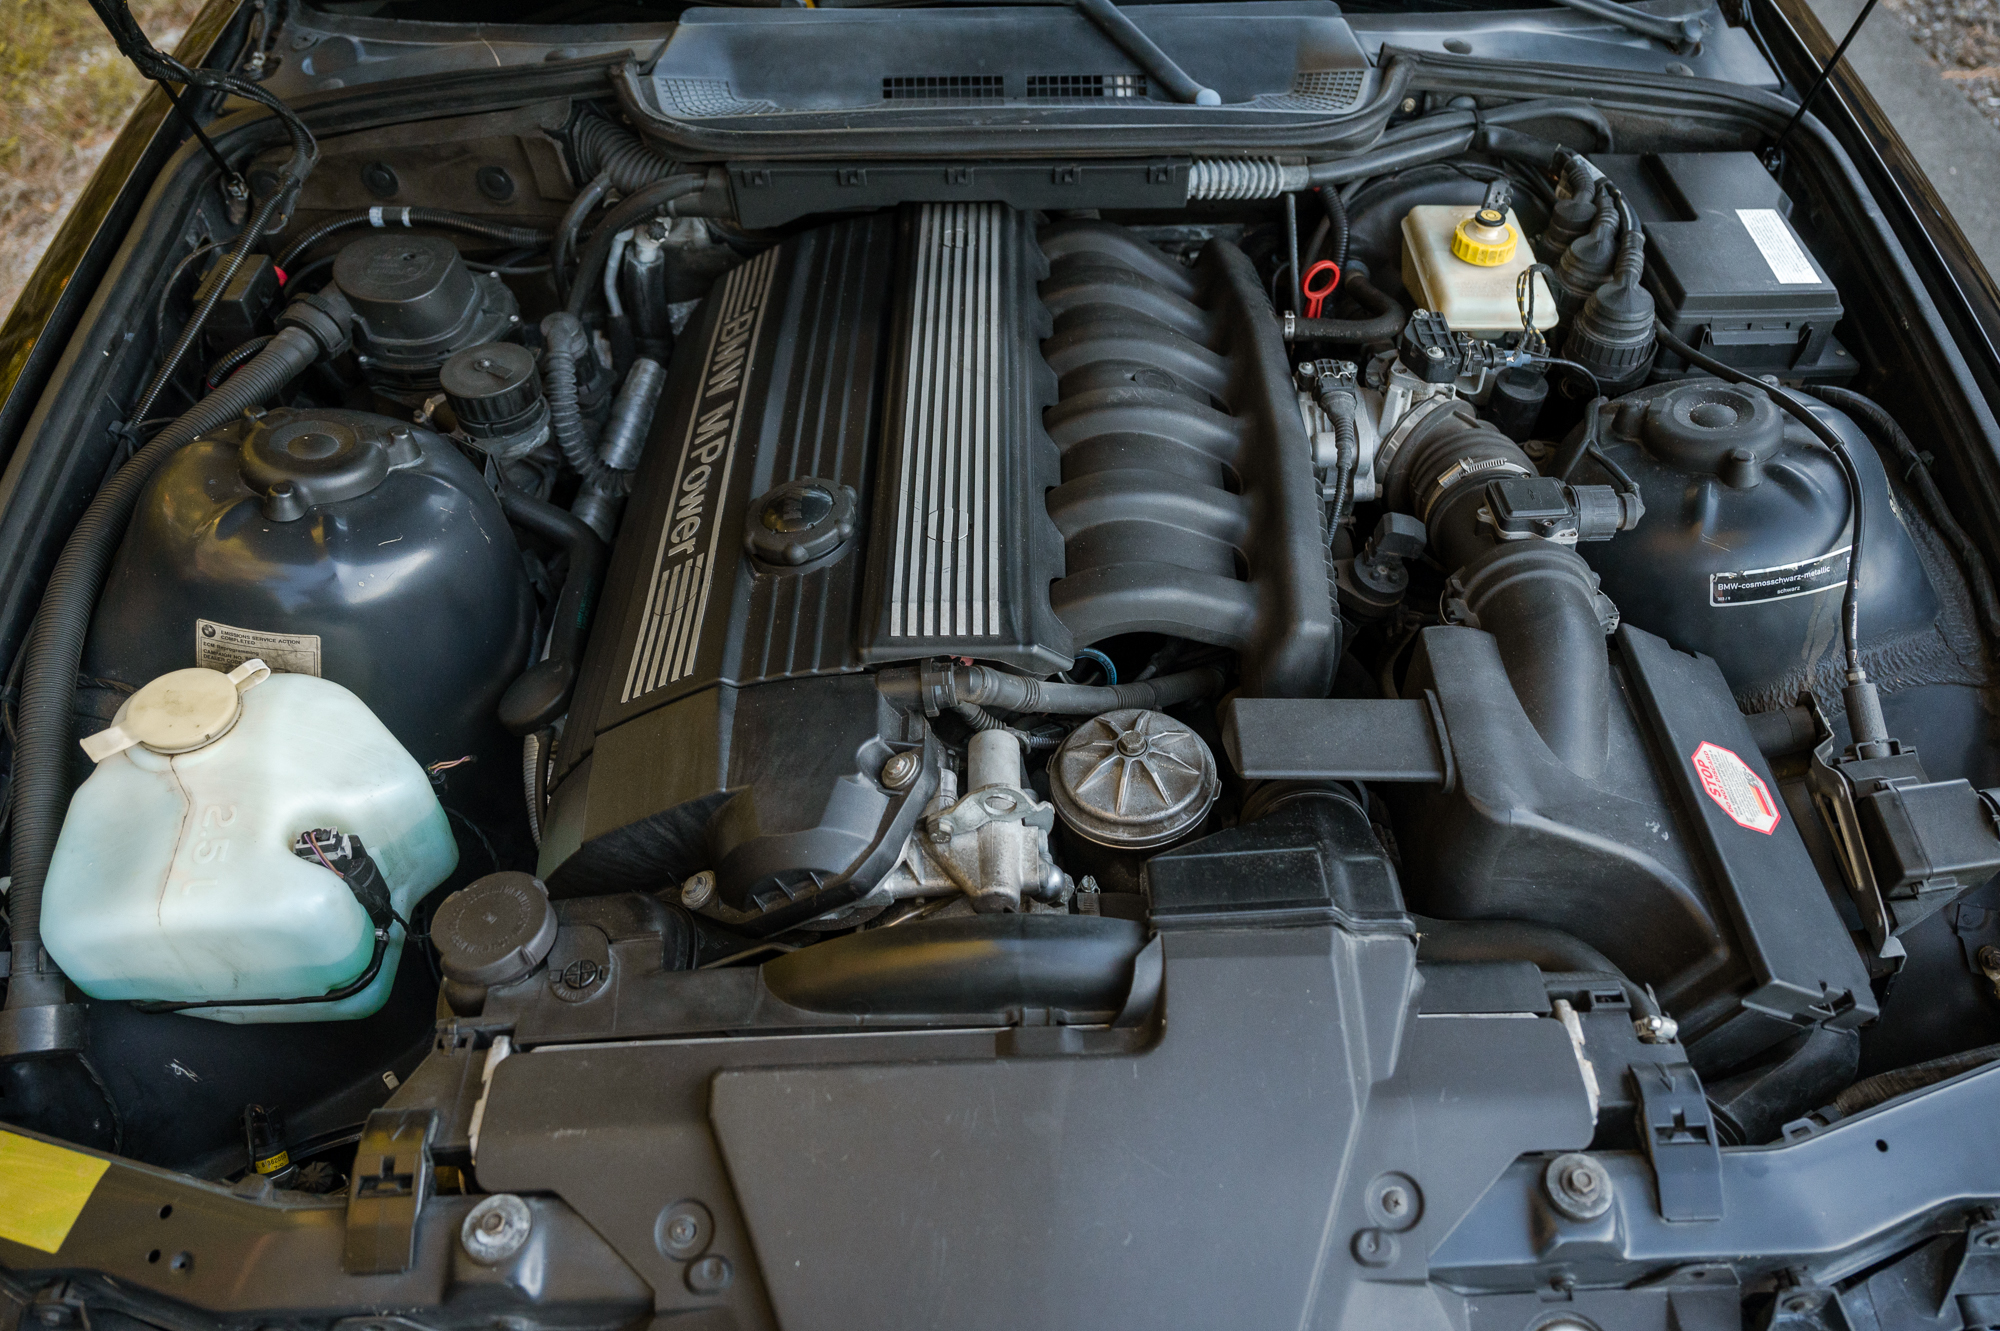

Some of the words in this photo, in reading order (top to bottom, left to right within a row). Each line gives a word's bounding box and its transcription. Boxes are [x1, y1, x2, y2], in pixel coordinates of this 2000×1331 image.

[705, 309, 754, 397] BMW
[1717, 565, 1831, 591] BMW-cosmosschwarz-metallic
[1776, 585, 1801, 594] schwarz
[220, 630, 251, 640] EMISSIONS
[252, 635, 276, 643] SERVICE
[220, 635, 256, 645] COMPLETED
[203, 648, 232, 658] CAMPAIGN
[216, 644, 260, 656] Reprogramming
[203, 654, 225, 662] DEALER
[1703, 750, 1721, 782] DISCARD
[1697, 758, 1722, 797] STOP
[1718, 783, 1729, 800] NOT
[1725, 801, 1733, 812] DO
[192, 804, 238, 865] 2.5
[181, 878, 218, 897] L
